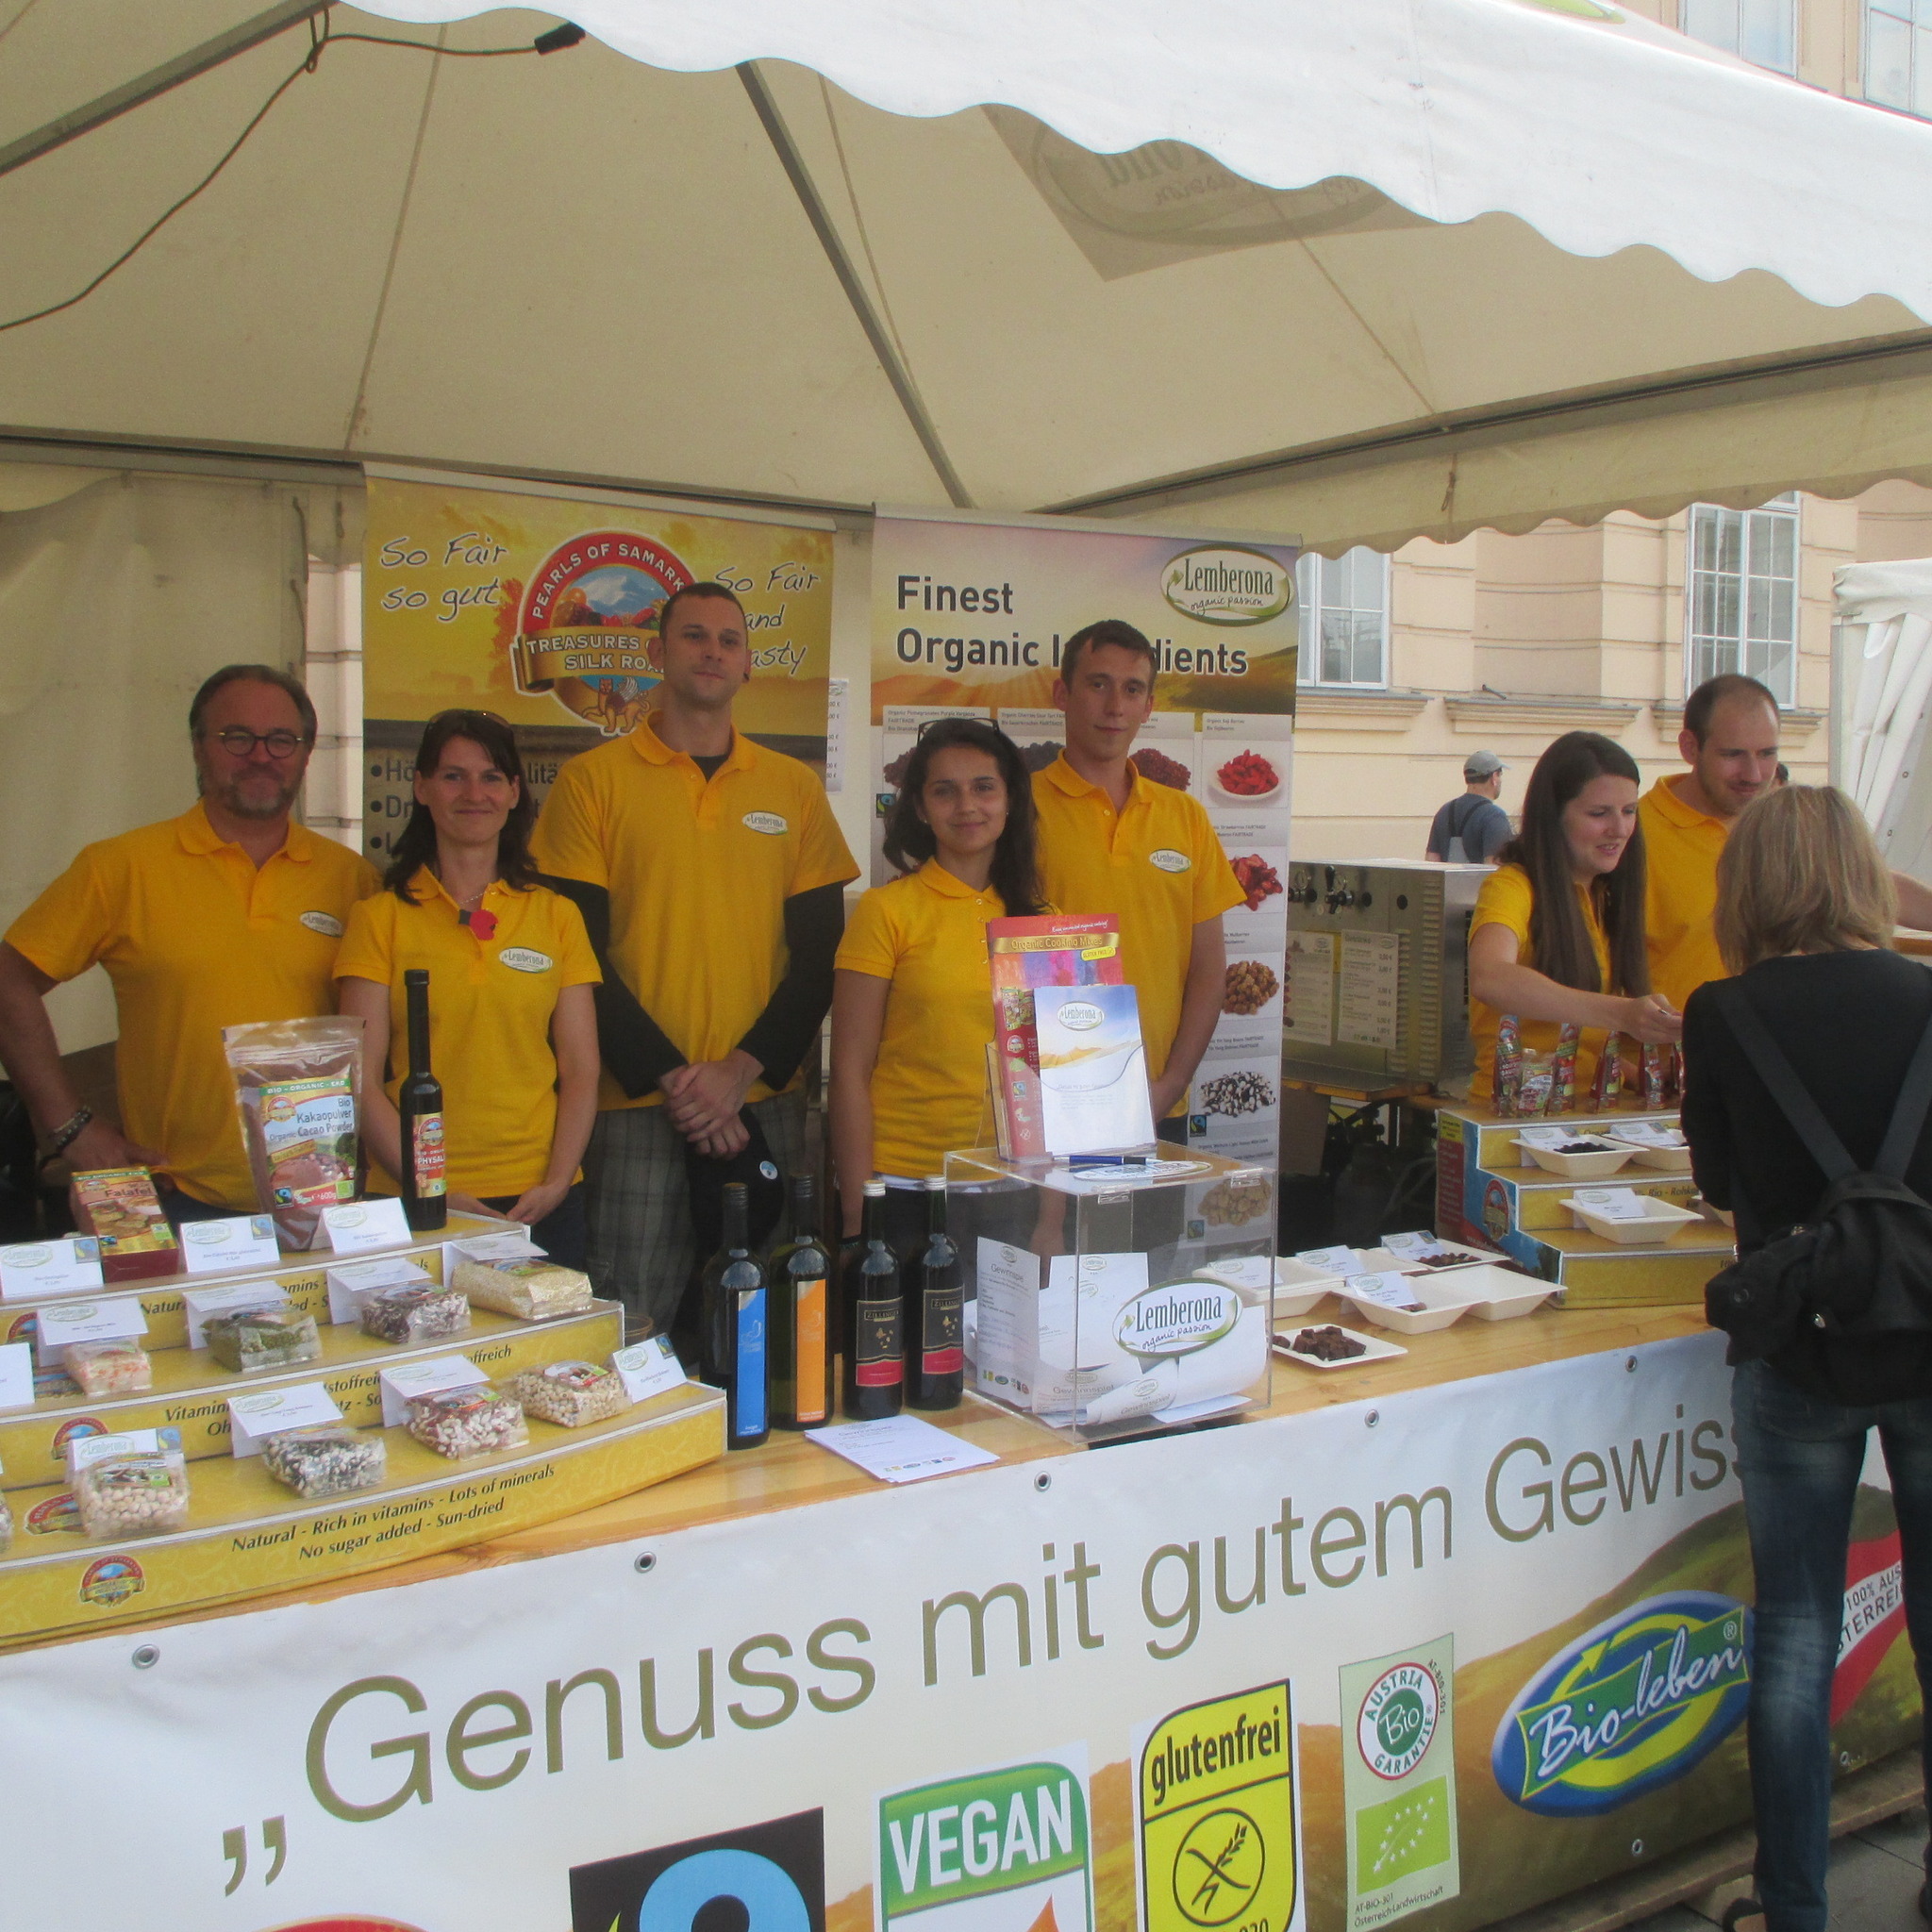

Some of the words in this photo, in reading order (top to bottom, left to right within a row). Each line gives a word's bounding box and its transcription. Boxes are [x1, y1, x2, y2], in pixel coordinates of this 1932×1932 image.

[380, 536, 428, 568] So
[442, 532, 508, 567] Fair
[531, 552, 583, 620] PEARLS
[587, 542, 611, 559] OF
[618, 543, 686, 591] SAMARK
[715, 566, 753, 593] So
[766, 561, 820, 592] Fair
[1184, 558, 1274, 595] Lemberona
[381, 586, 428, 611] so
[436, 576, 501, 625] gut
[897, 575, 1014, 615] Finest
[1190, 595, 1225, 617] organic
[1227, 596, 1264, 608] passion
[525, 635, 641, 656] TREASURES
[564, 653, 613, 671] SILK
[751, 640, 808, 675] asty
[896, 626, 1040, 673] Organic
[508, 950, 544, 966] Lemberona
[1010, 939, 1044, 951] Organic
[1045, 937, 1078, 947] Cooking
[1079, 937, 1103, 946] Mixes
[290, 1082, 325, 1091] ORGANIC
[338, 1097, 351, 1107] Bio
[296, 1108, 352, 1124] Kakaopulver
[297, 1125, 325, 1138] Cacao
[325, 1122, 354, 1133] Powder
[105, 1188, 152, 1198] Falafel
[1135, 1295, 1223, 1333] Lemberona
[1141, 1328, 1174, 1354] organic
[1176, 1324, 1212, 1340] passion
[165, 1399, 229, 1423] Vitamin
[207, 1419, 232, 1437] Oh
[231, 1524, 297, 1552] Natural
[312, 1514, 347, 1536] Rich
[352, 1511, 367, 1526] in
[373, 1497, 434, 1522] vitamins
[449, 1486, 477, 1503] Lots
[481, 1477, 498, 1494] of
[499, 1463, 555, 1490] minerals
[299, 1544, 324, 1560] No
[328, 1534, 372, 1555] sugar
[375, 1518, 423, 1542] added
[436, 1496, 506, 1528] Sun-dried
[921, 1541, 1105, 1687] mit
[1140, 1485, 1453, 1661] gutem
[1845, 1581, 1875, 1612] 100%
[1839, 1584, 1900, 1655] TERREI
[1364, 1669, 1424, 1723] AUSTRIA
[1528, 1624, 1744, 1777] Bio-leben
[1378, 1703, 1421, 1745] Bio
[1150, 1705, 1282, 1807] glutenfrei
[1374, 1716, 1434, 1774] GARANTIE
[888, 1778, 1074, 1895] VEGAN
[1354, 1885, 1444, 1927] Österreich-Landwirtschaft
